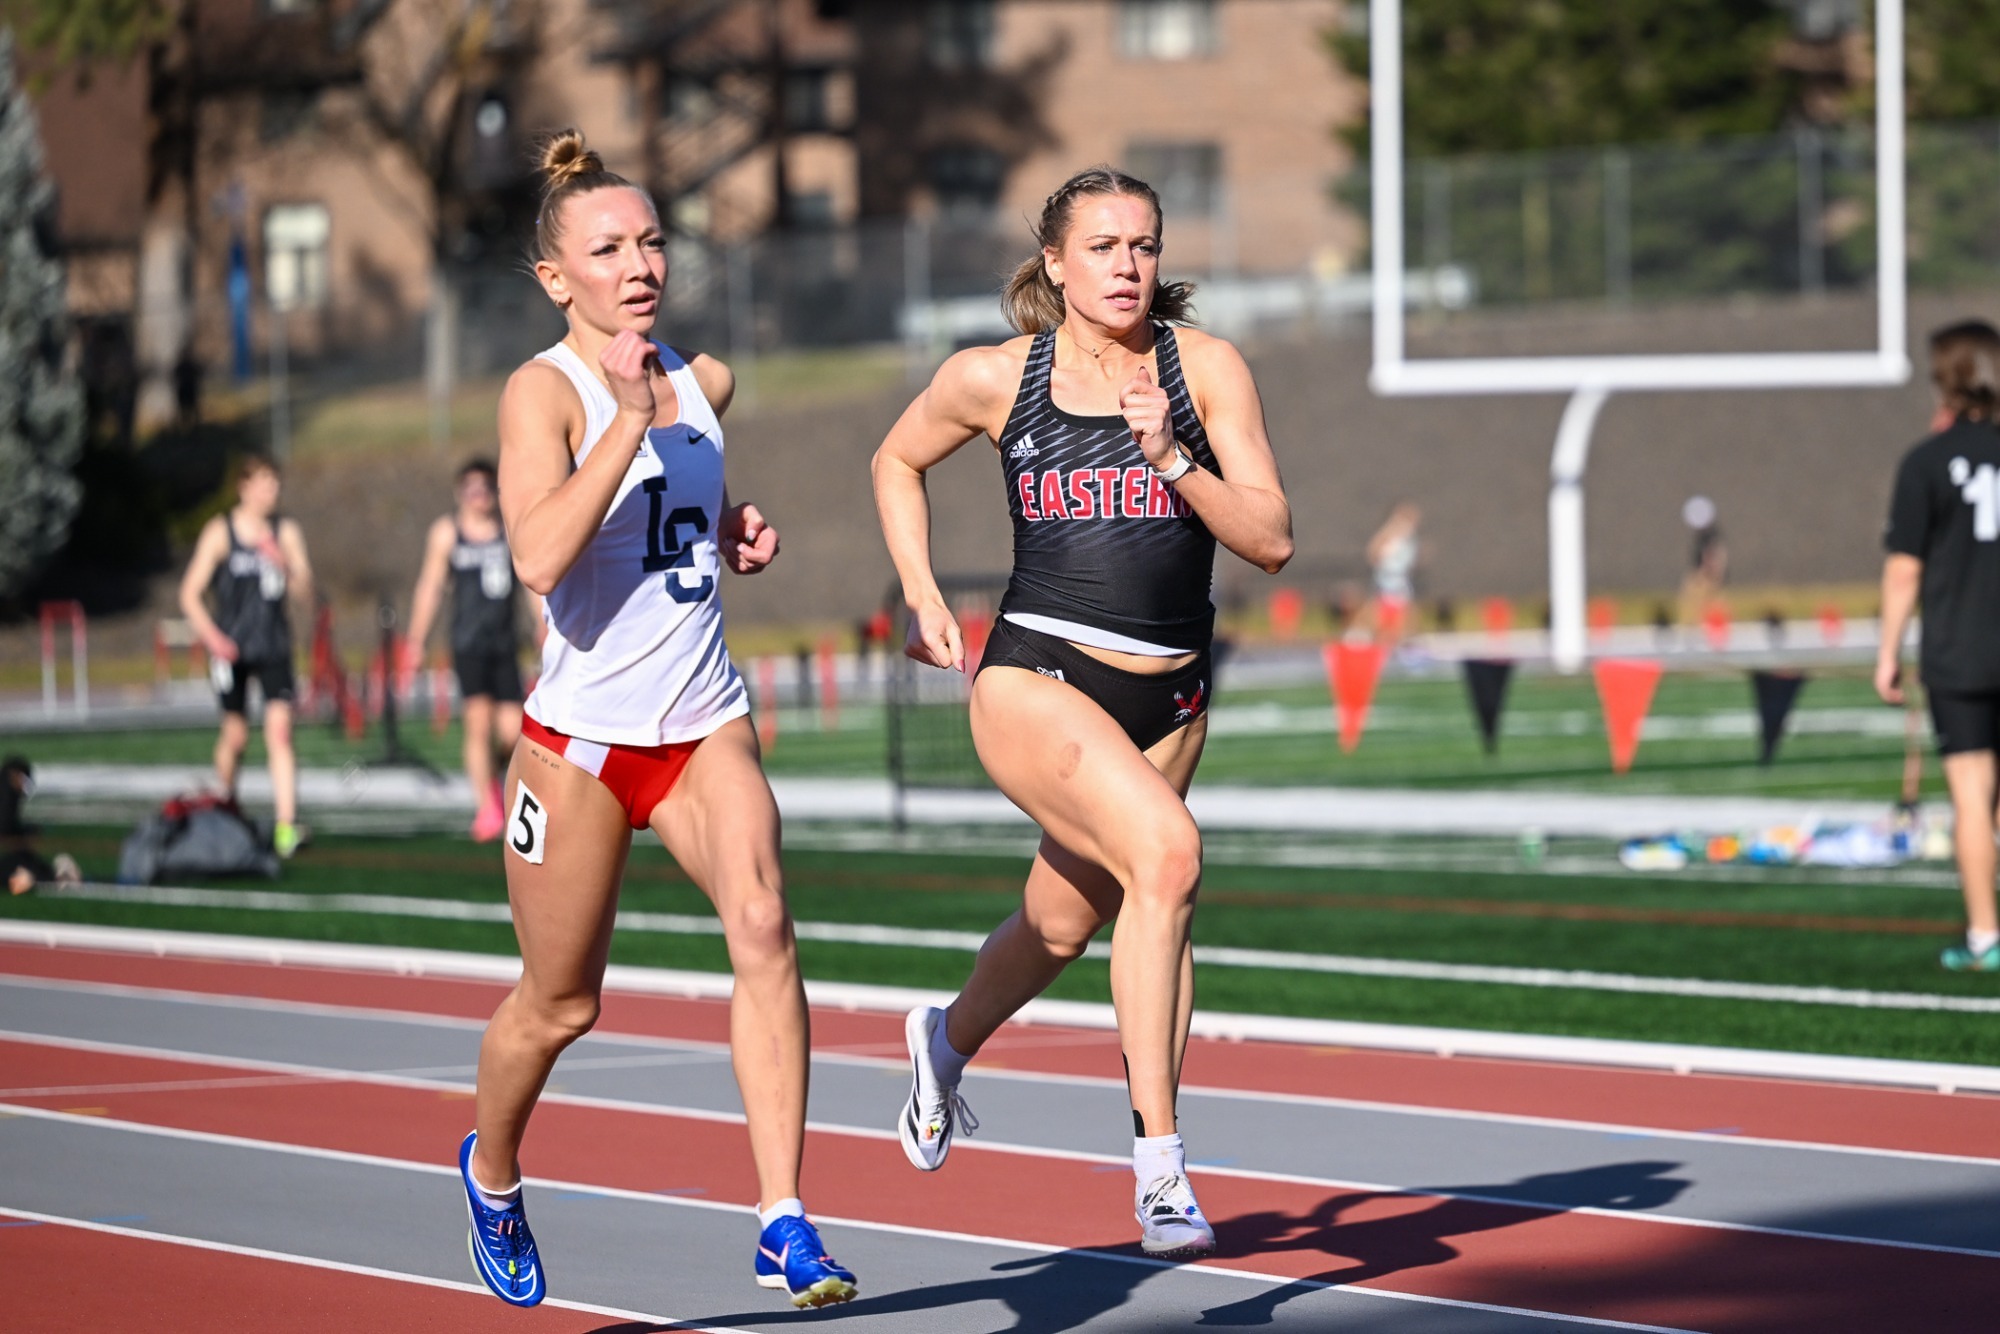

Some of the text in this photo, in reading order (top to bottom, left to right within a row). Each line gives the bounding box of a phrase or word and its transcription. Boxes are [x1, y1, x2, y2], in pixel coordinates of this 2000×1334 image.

[1009, 447, 1040, 459] adidas
[642, 476, 714, 604] LC
[513, 792, 539, 854] 5
